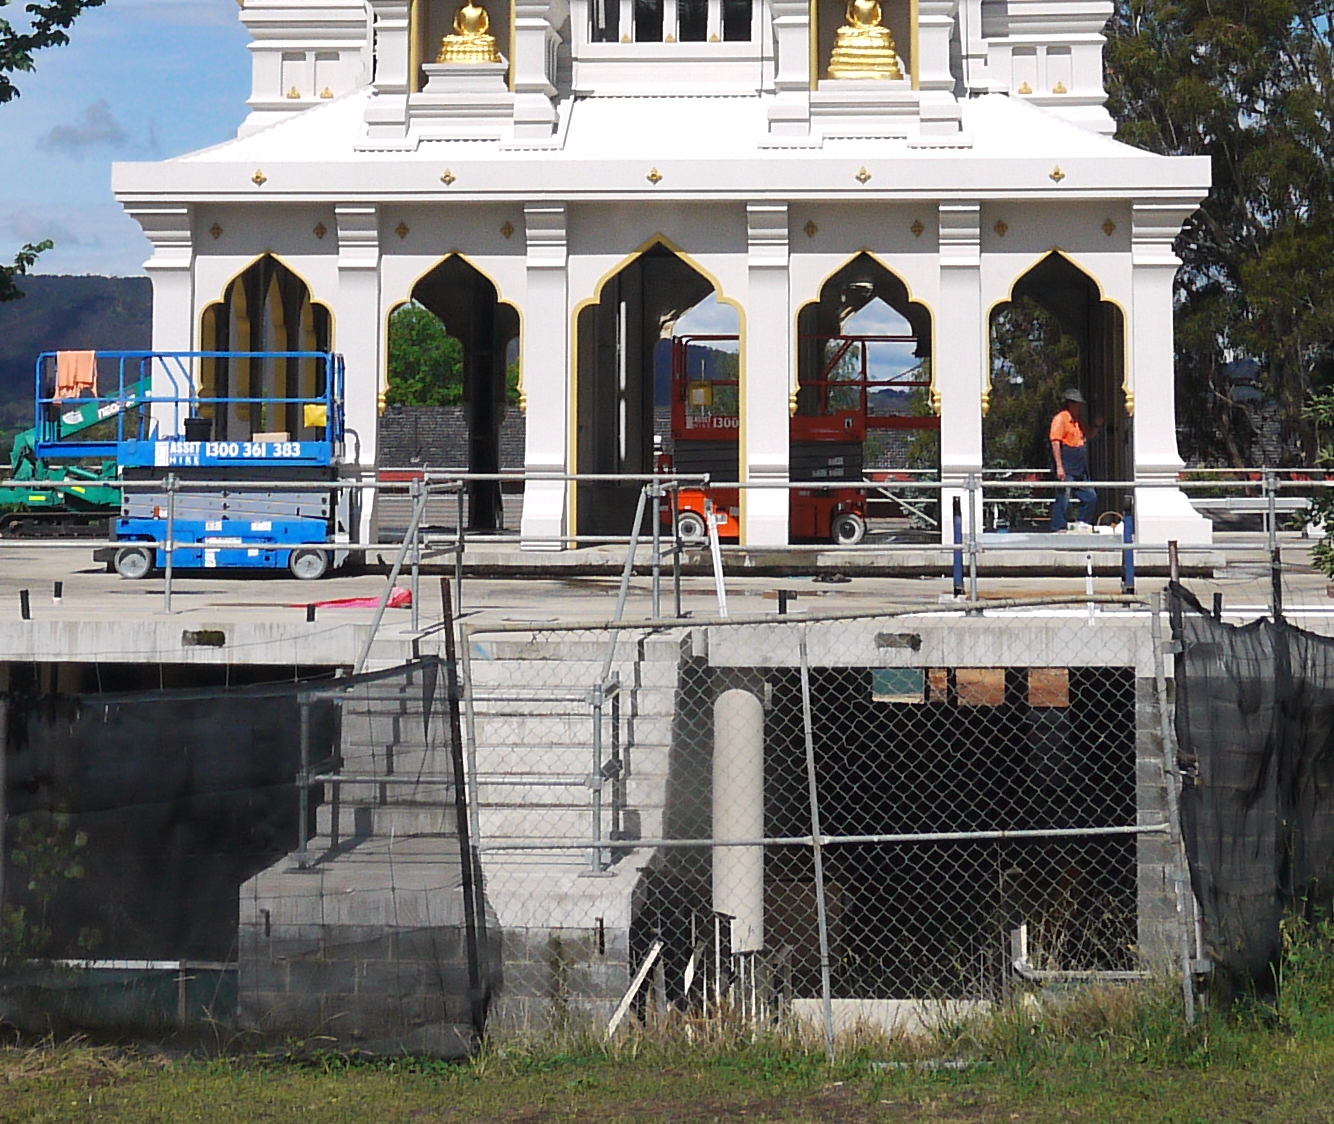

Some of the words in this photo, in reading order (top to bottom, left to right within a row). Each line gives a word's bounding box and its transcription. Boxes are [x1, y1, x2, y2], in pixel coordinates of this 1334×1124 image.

[713, 417, 739, 428] 1300
[170, 441, 201, 453] ASSET
[206, 442, 239, 457] 1300
[243, 442, 266, 458] 361
[273, 442, 301, 457] 383
[170, 456, 200, 466] HIRE
